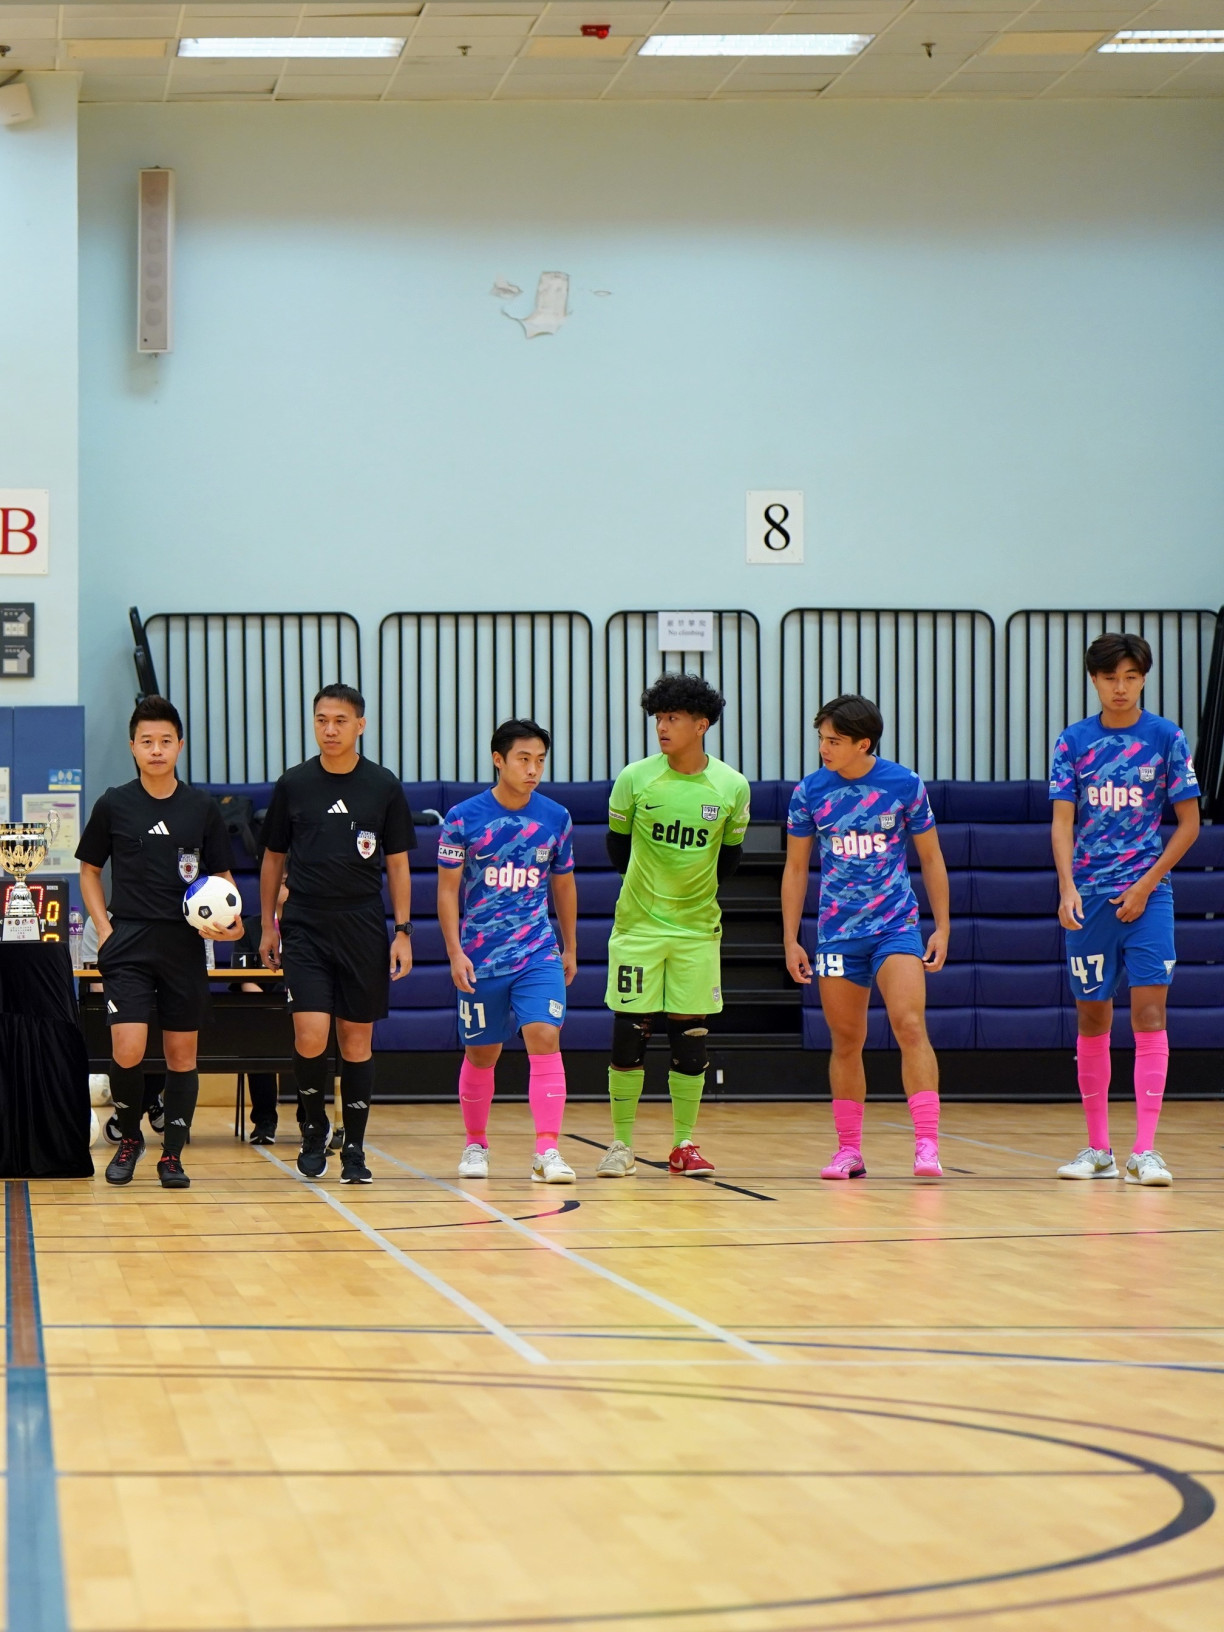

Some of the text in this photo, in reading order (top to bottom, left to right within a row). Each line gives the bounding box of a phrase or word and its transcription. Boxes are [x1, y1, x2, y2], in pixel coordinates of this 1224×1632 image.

[763, 503, 790, 551] 8
[1087, 780, 1144, 812] edps
[651, 819, 709, 849] edps
[831, 830, 888, 859] edps
[484, 861, 540, 892] edps
[46, 901, 60, 923] 0
[239, 955, 247, 967] 1
[816, 953, 844, 977] 49
[1070, 953, 1104, 984] 47
[617, 965, 643, 994] 61
[459, 999, 486, 1029] 41
